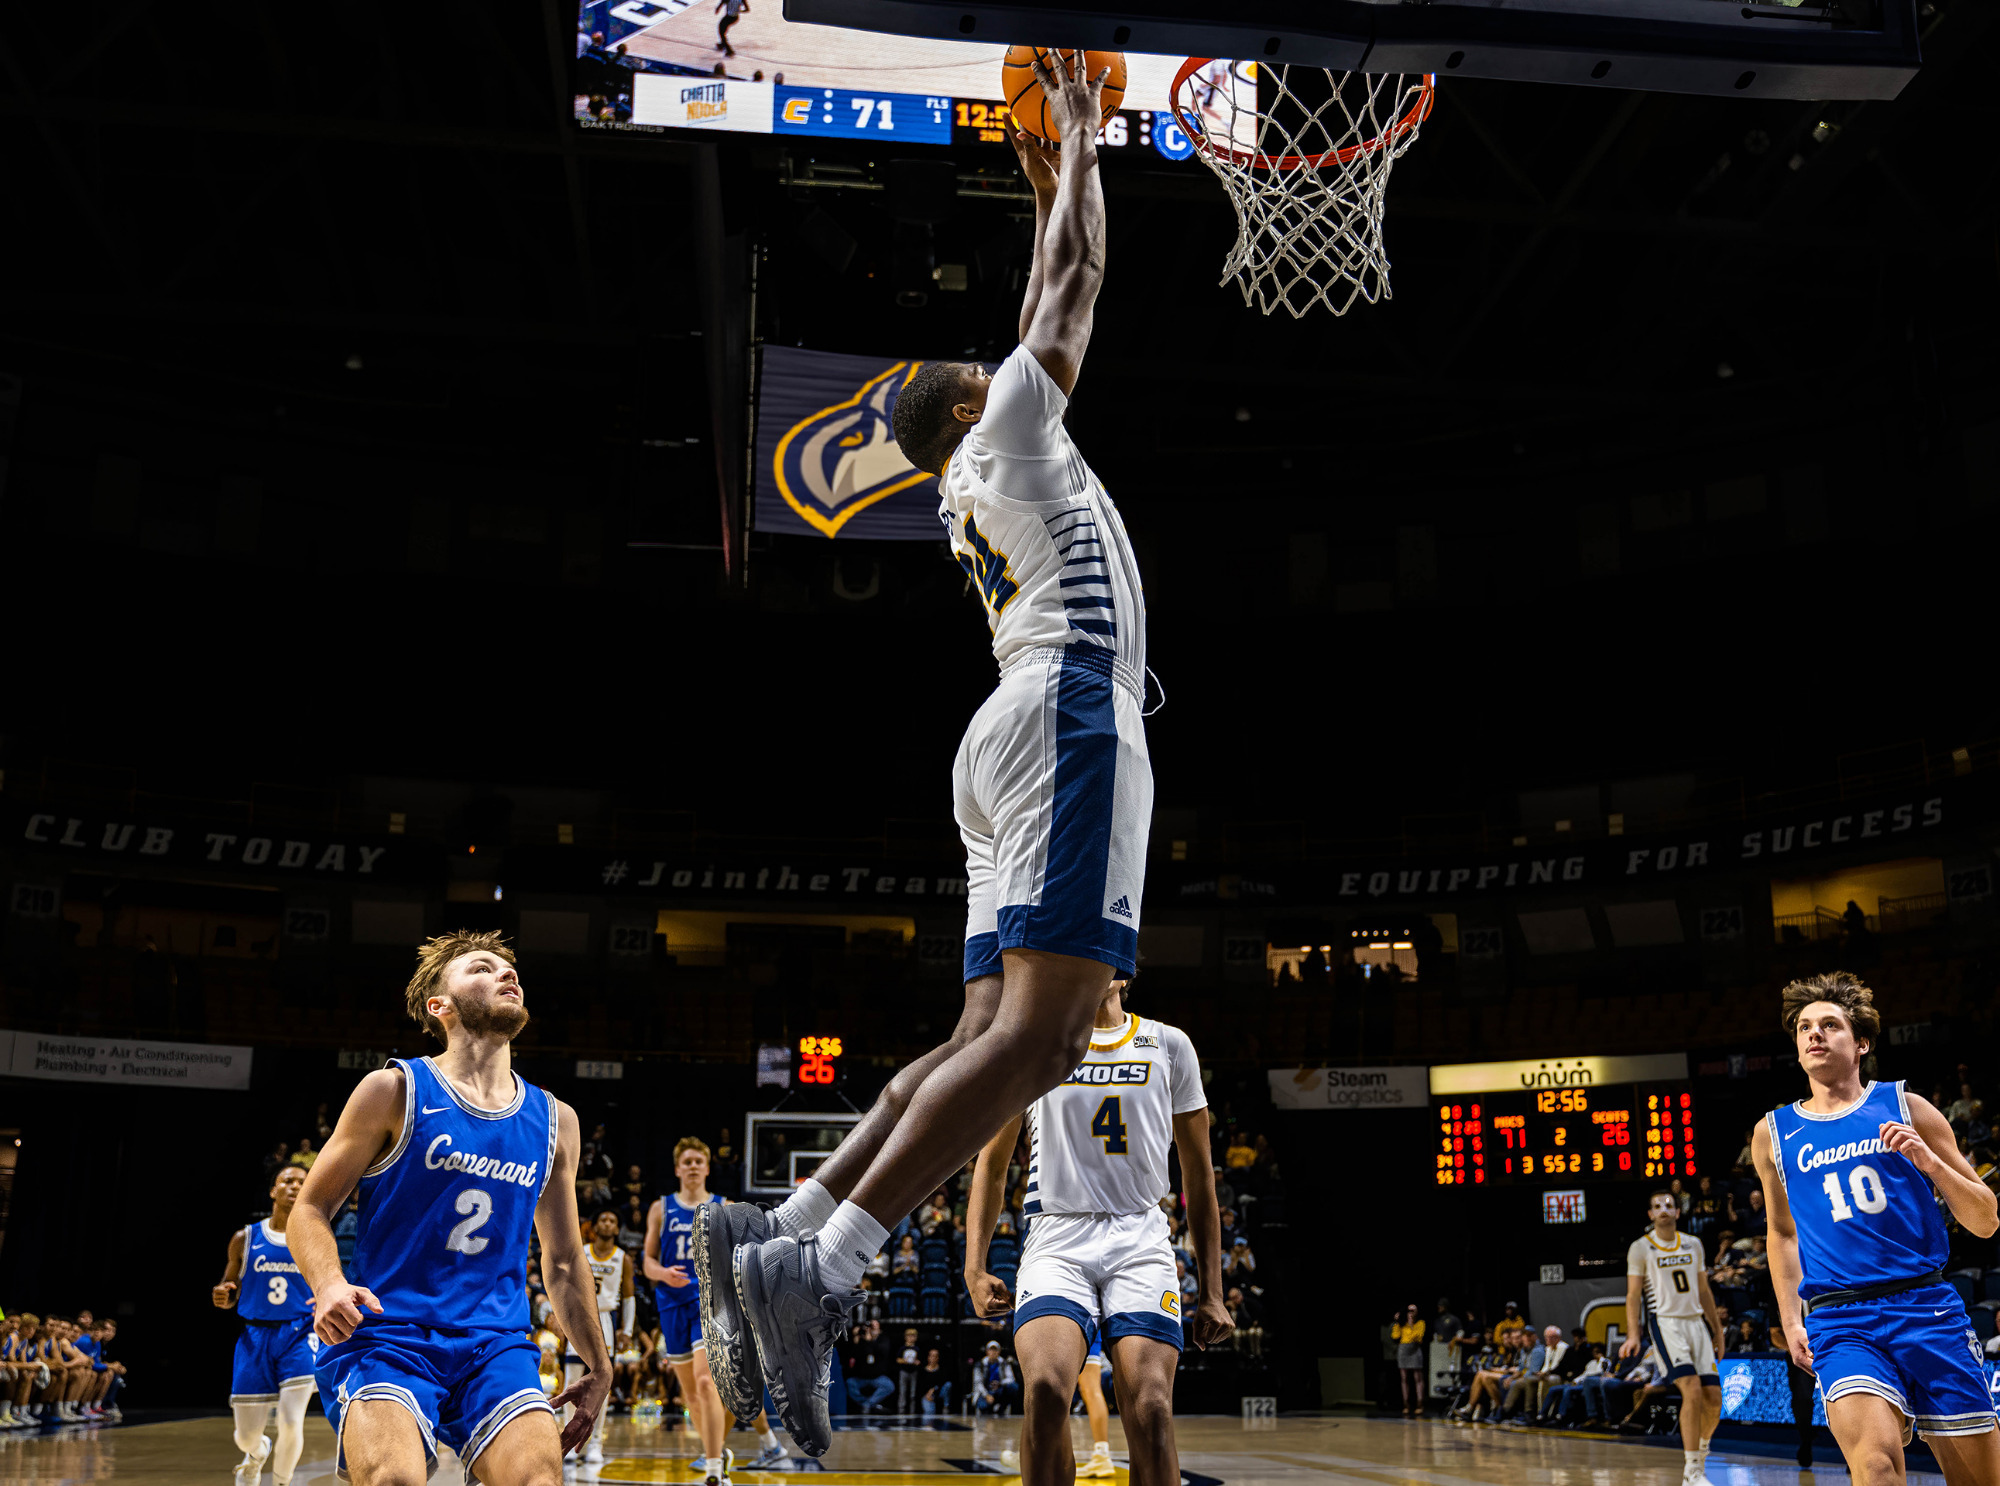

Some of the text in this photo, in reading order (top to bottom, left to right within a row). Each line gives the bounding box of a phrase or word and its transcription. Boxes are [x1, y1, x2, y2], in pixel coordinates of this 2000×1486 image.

[851, 98, 895, 130] 71
[926, 97, 949, 109] FLS
[933, 110, 942, 124] 1
[956, 103, 1019, 130] 12:5
[25, 813, 385, 873] CLUB TODAY
[1339, 798, 1942, 897] EQUIPPING FOR SUCCESS
[1109, 906, 1132, 919] adidas
[37, 1040, 232, 1067] Heating Air Conditioning
[800, 1036, 842, 1057] 12:56
[35, 1057, 107, 1075] Plumbing
[799, 1053, 835, 1084] 26
[1327, 1070, 1388, 1088] Steam
[1327, 1088, 1404, 1109] Logistics
[1537, 1089, 1588, 1113] 12:56
[1091, 1095, 1128, 1155] 4
[1554, 1127, 1567, 1146] 2
[1602, 1122, 1631, 1146] 26
[1500, 1128, 1527, 1149] 71
[425, 1133, 538, 1188] Covenant
[1522, 1155, 1535, 1174] 3
[1592, 1152, 1604, 1172] 3
[1618, 1151, 1632, 1171] 0
[1797, 1138, 1896, 1173] Covenan
[1822, 1164, 1888, 1223] 10
[445, 1188, 494, 1256] 2
[1658, 1255, 1691, 1268] MOCS
[267, 1275, 288, 1305] 3
[1672, 1269, 1690, 1294] 0
[1160, 1290, 1180, 1317] C
[1244, 1400, 1273, 1417] 122
